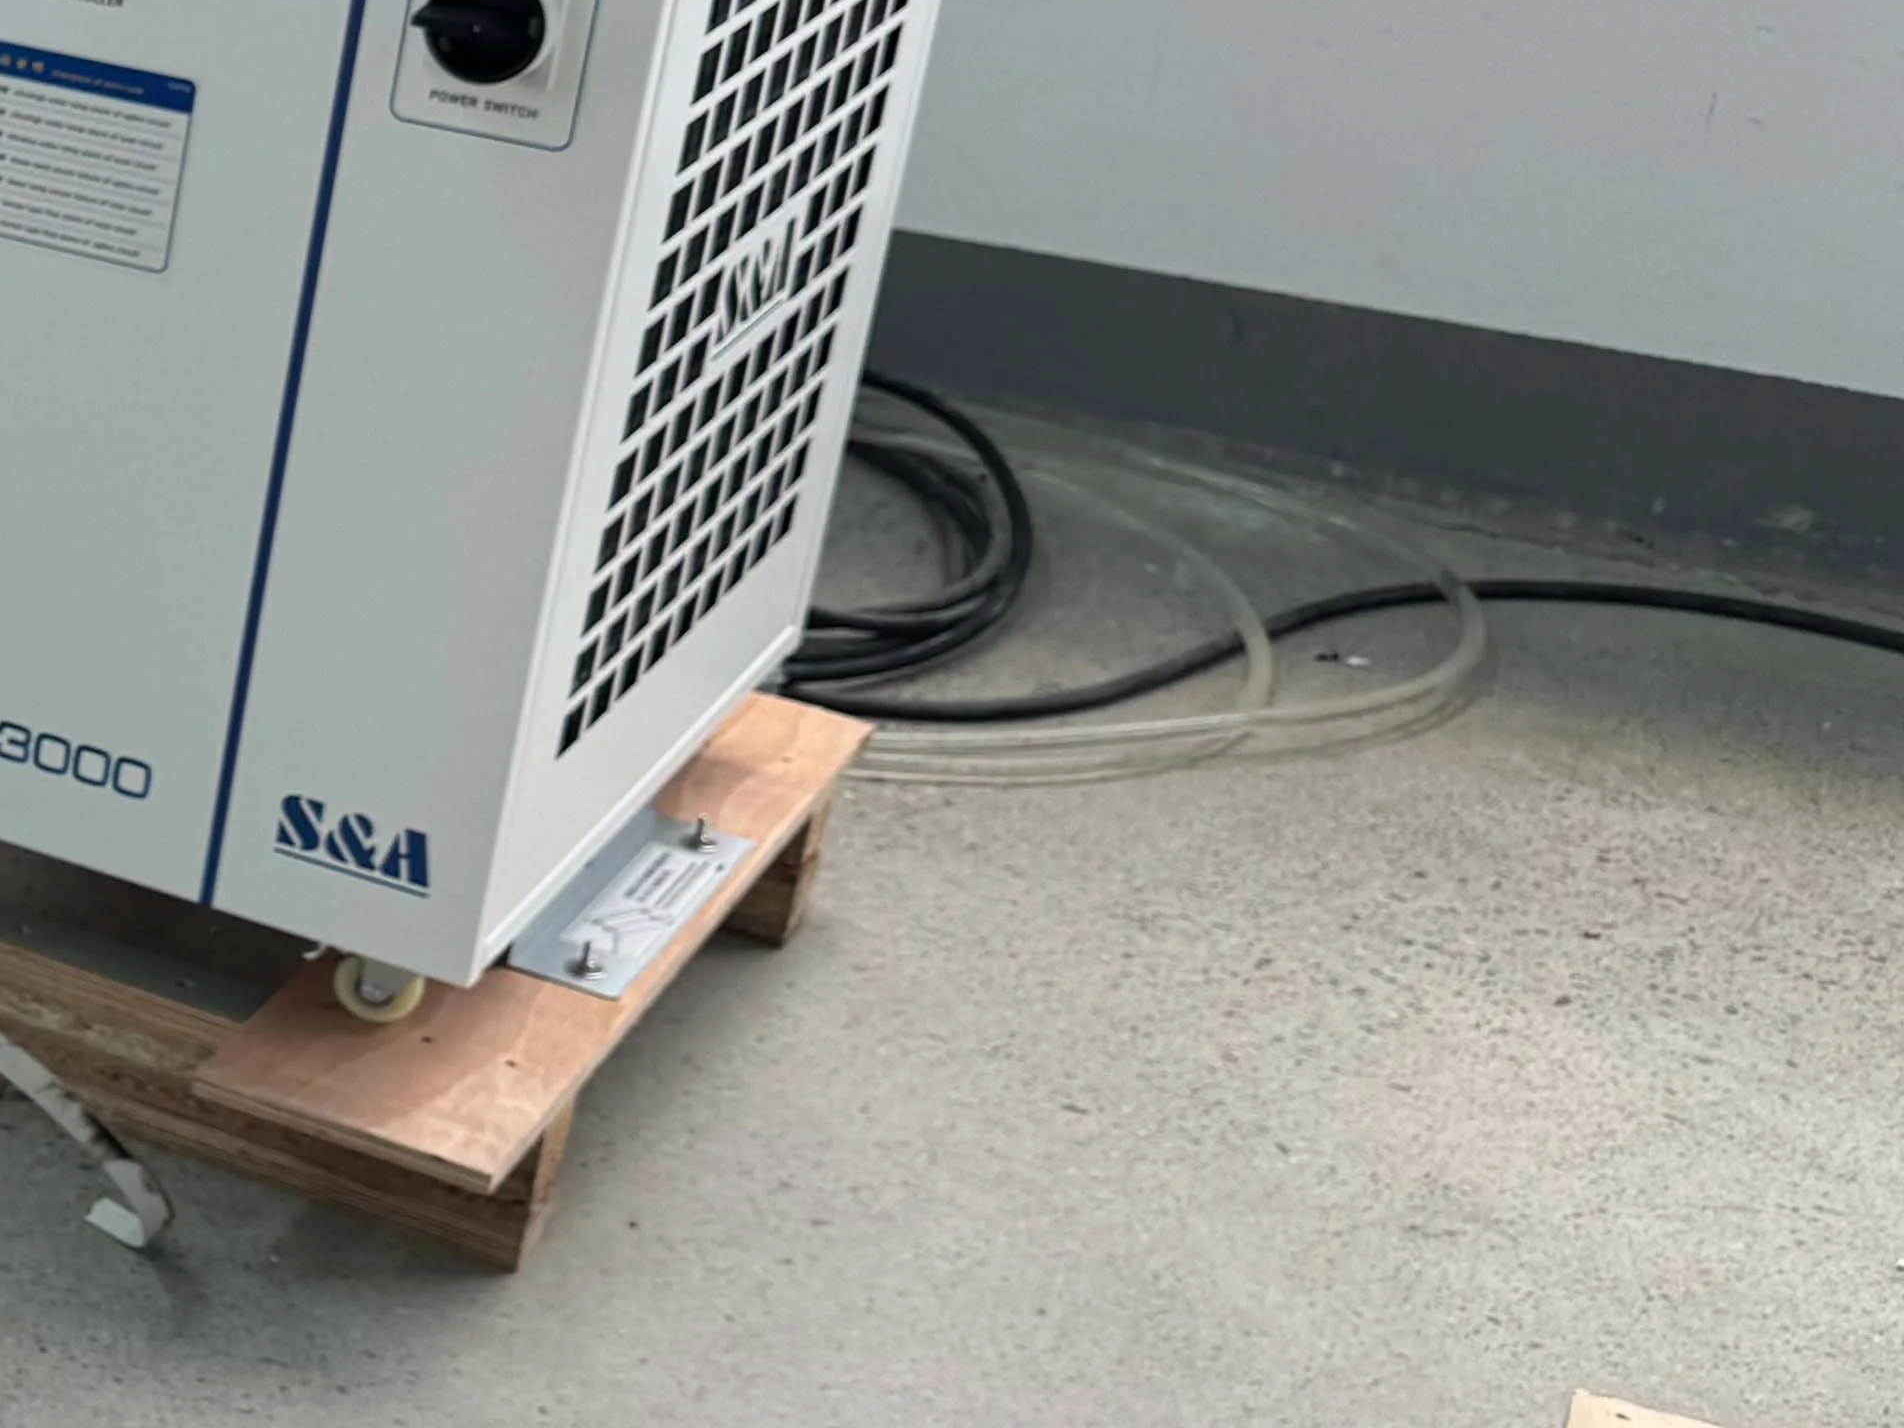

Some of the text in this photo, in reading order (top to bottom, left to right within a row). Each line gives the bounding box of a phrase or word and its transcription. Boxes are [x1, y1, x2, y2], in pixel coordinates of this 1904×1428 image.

[429, 88, 539, 120] POWER SWITCH
[276, 795, 429, 889] S&A
